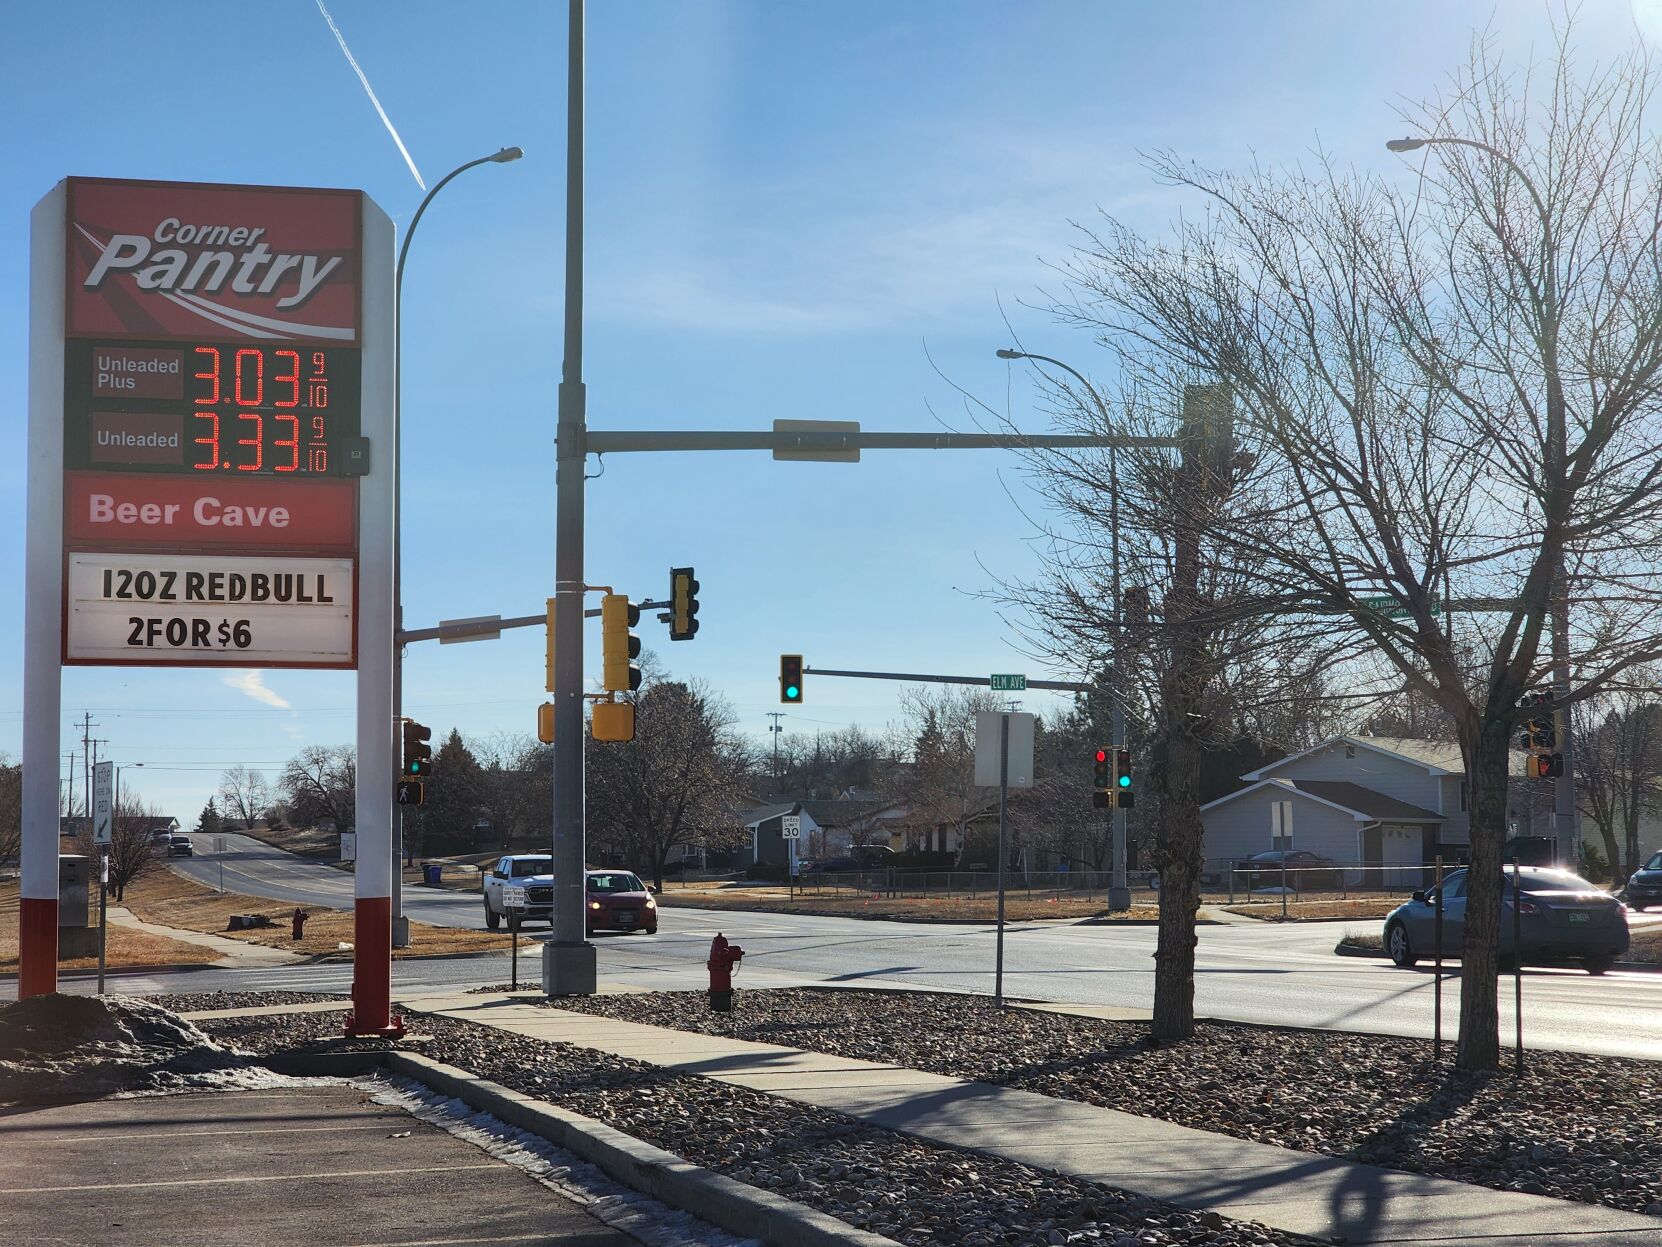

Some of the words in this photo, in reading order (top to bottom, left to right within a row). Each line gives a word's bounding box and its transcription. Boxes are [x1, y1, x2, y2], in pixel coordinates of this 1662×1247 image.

[154, 217, 266, 249] Corner
[84, 234, 343, 309] Pantry
[98, 356, 179, 374] Unleaded
[194, 347, 299, 407] 3.03
[98, 374, 136, 389] Plus
[97, 431, 179, 448] Unleaded
[194, 411, 299, 472] 3.33
[89, 493, 180, 525] Beer
[193, 496, 291, 528] Cave
[185, 571, 334, 603] REDBULL
[992, 676, 1007, 689] ELM
[1010, 676, 1024, 689] AVE
[784, 827, 799, 837] 30
